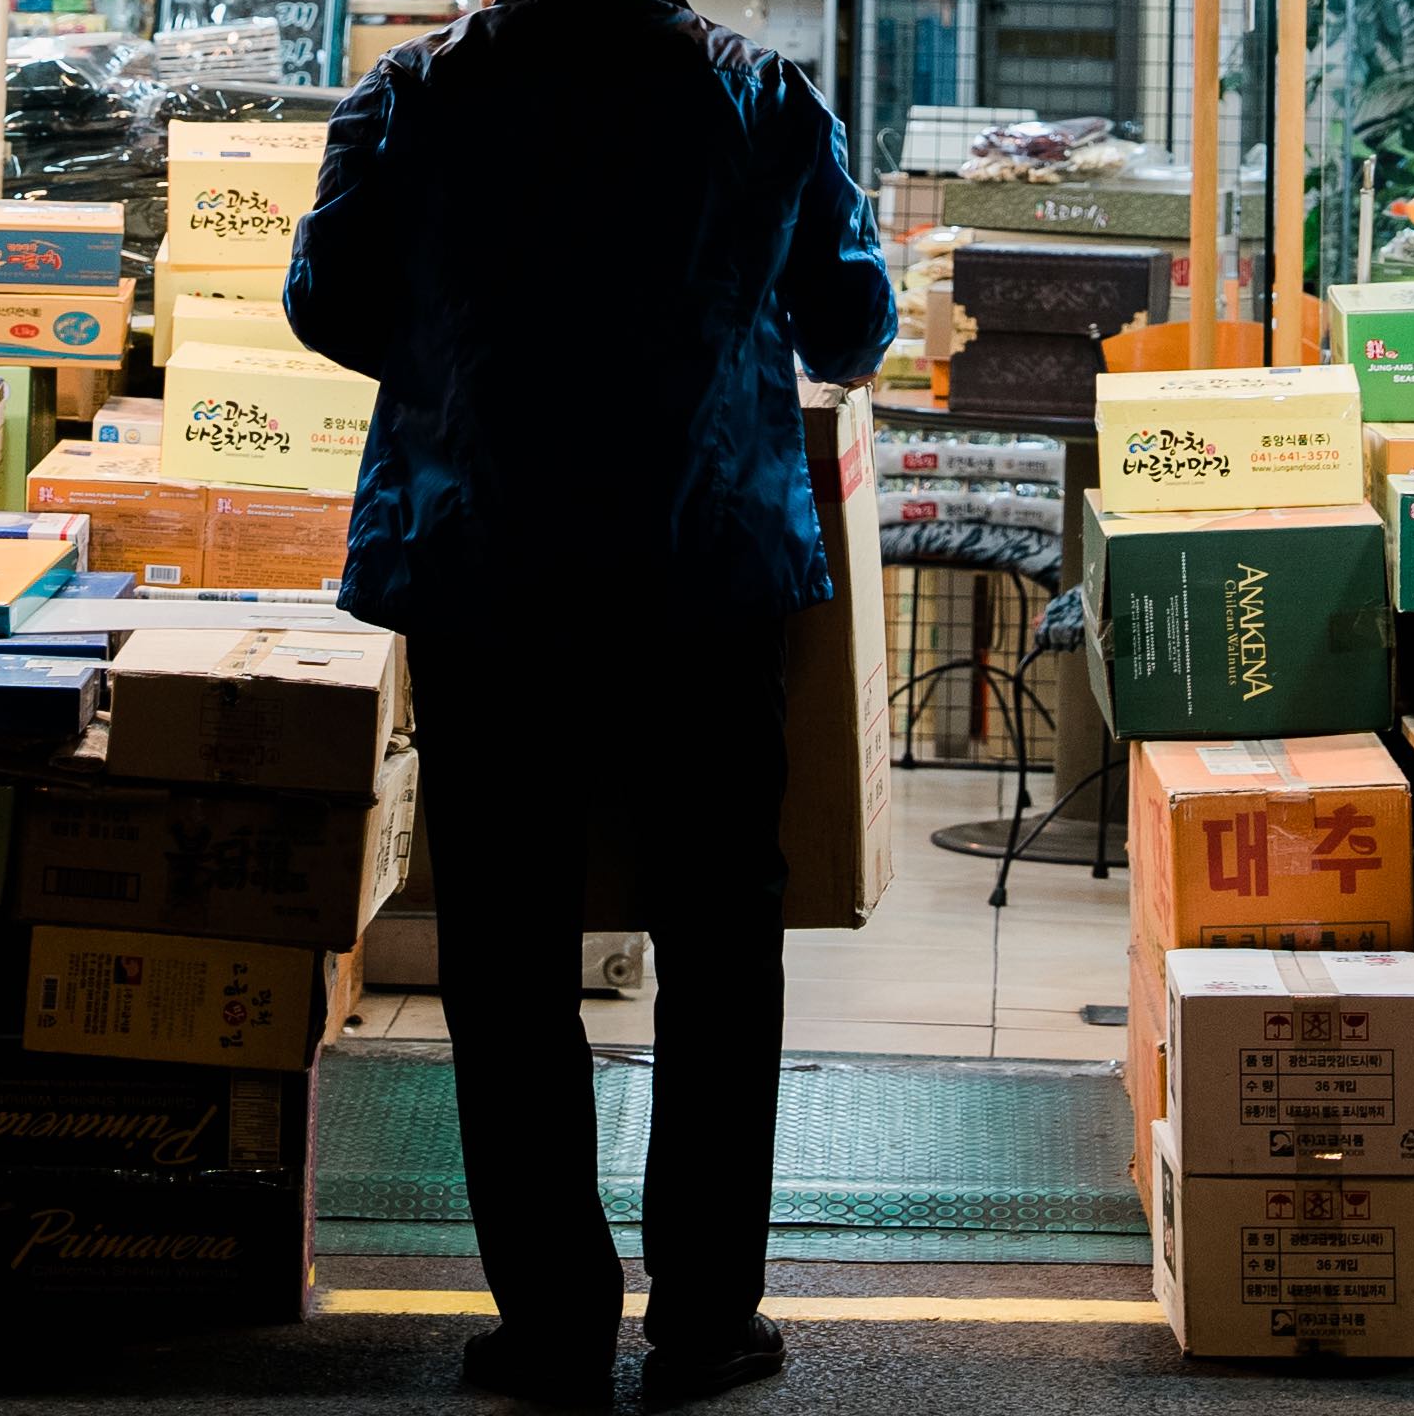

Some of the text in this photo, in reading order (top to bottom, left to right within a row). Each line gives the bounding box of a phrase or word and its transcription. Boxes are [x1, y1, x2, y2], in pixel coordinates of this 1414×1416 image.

[225, 189, 270, 214] 광천
[190, 211, 292, 239] 바른찬맛김
[224, 400, 269, 431] 광천
[186, 423, 291, 455] 바른찬맛김
[1159, 429, 1206, 455] 광천
[1260, 433, 1331, 448] 중앙식품(주)
[1123, 452, 1232, 482] 바른찬맛김
[1250, 449, 1340, 463] 041-641-3570
[1224, 579, 1239, 687] Chilean Walnuts
[1237, 562, 1275, 702] ANAKENA
[1201, 802, 1384, 897] 대추
[1315, 1080, 1330, 1092] 36
[1334, 1079, 1357, 1093] 개입
[1296, 1134, 1365, 1147] (주)고급식품
[9, 1207, 244, 1271] Primavera
[1317, 1258, 1331, 1270] 36
